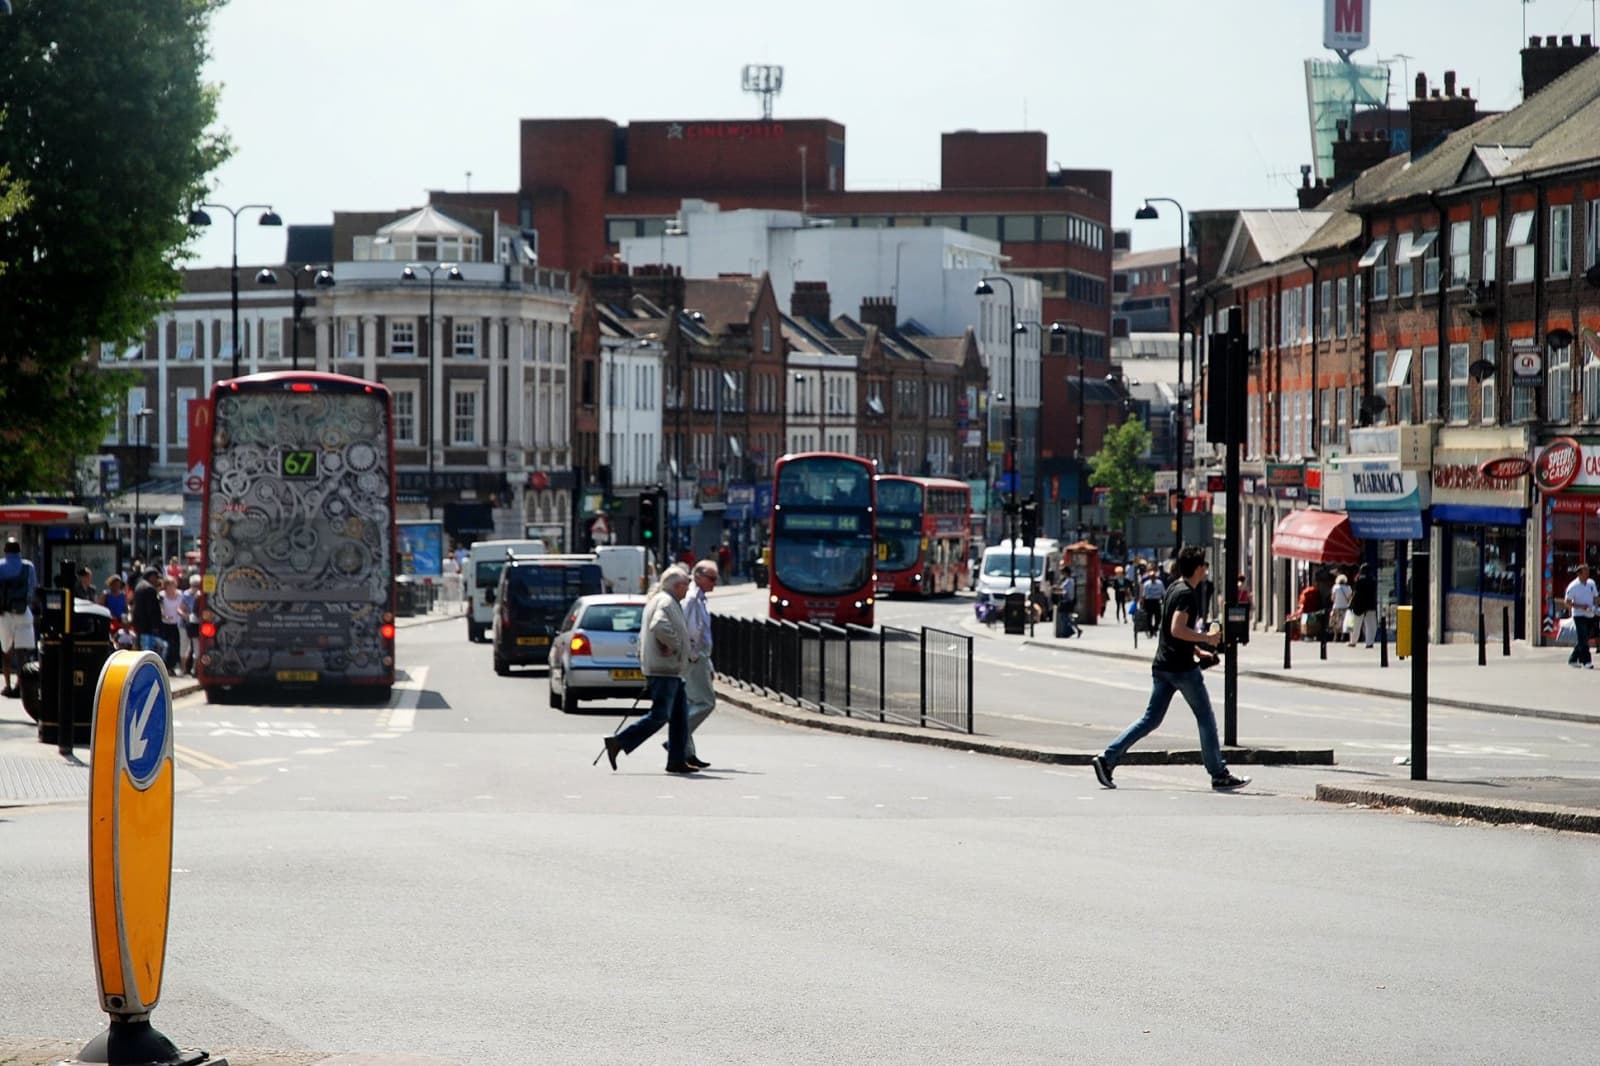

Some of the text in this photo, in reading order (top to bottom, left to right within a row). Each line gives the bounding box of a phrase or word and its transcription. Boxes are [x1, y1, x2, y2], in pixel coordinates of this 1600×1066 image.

[284, 452, 315, 475] 67
[1549, 462, 1571, 481] CASH
[1352, 472, 1405, 494] PHARMACY
